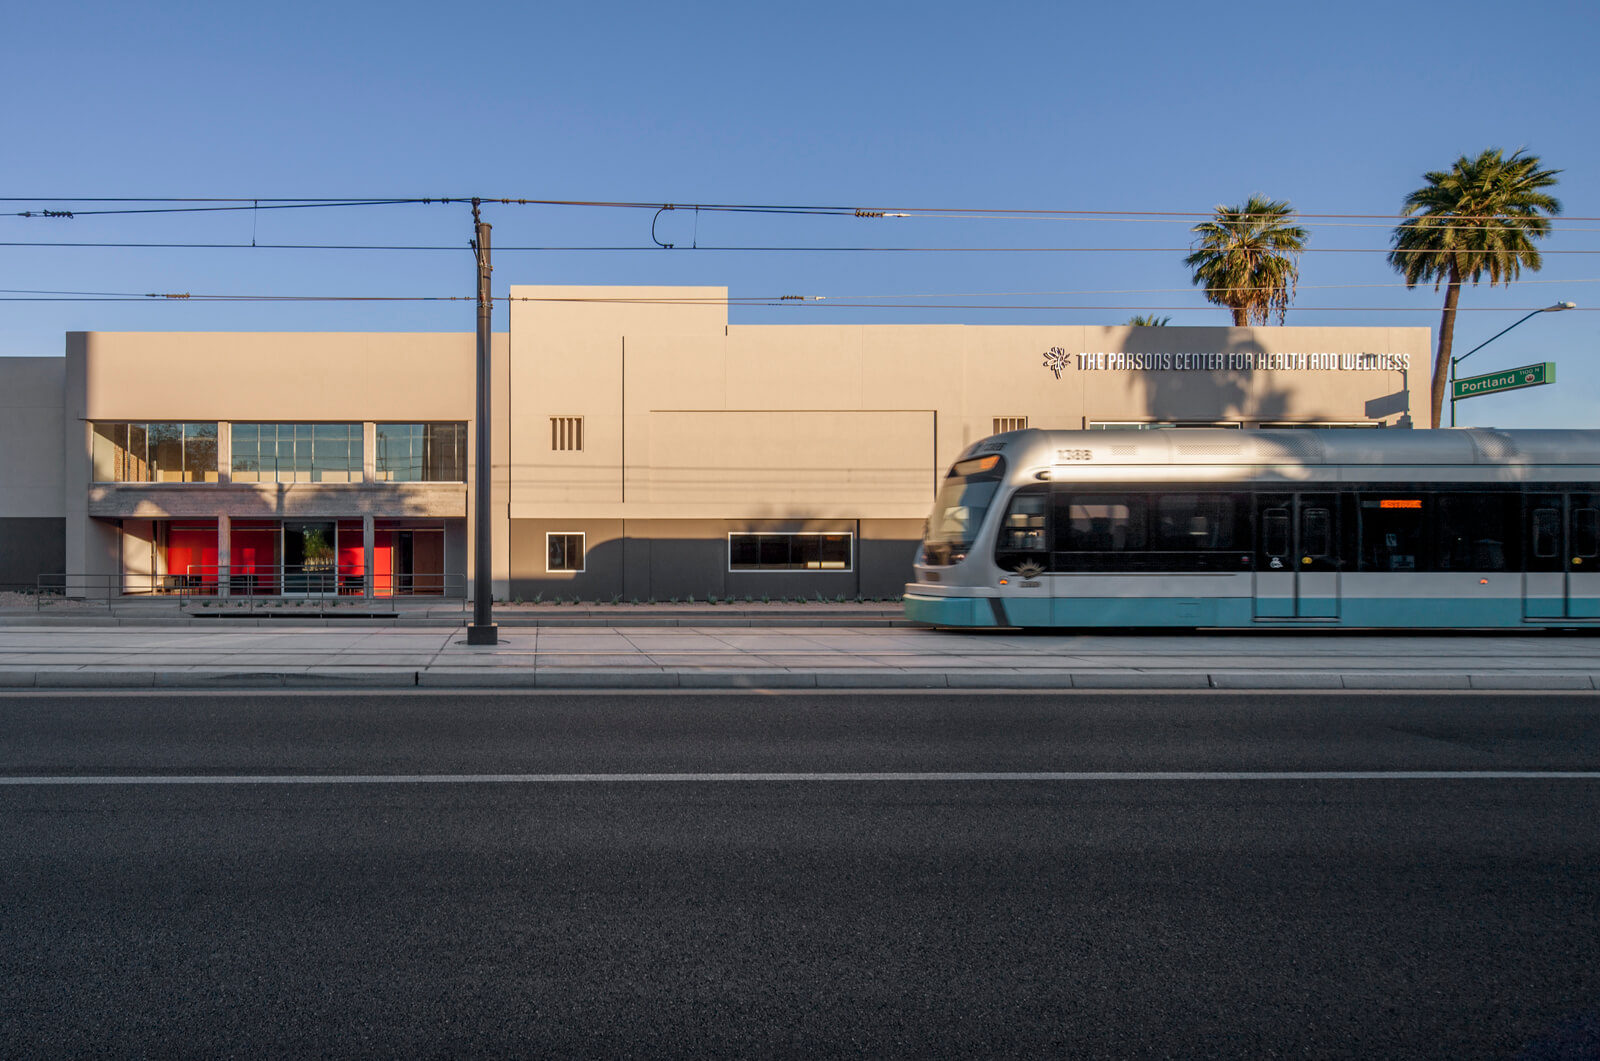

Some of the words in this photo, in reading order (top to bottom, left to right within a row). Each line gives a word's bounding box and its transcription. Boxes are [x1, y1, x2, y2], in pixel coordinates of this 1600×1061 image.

[1079, 352, 1104, 370] THE
[1108, 352, 1171, 370] PARSONS
[1175, 352, 1224, 370] CENTER
[1229, 352, 1253, 370] FOR
[1258, 352, 1306, 370] HEALTH
[1311, 352, 1338, 370] AND
[1342, 352, 1410, 370] WELLNESS
[1461, 374, 1515, 393] Portland
